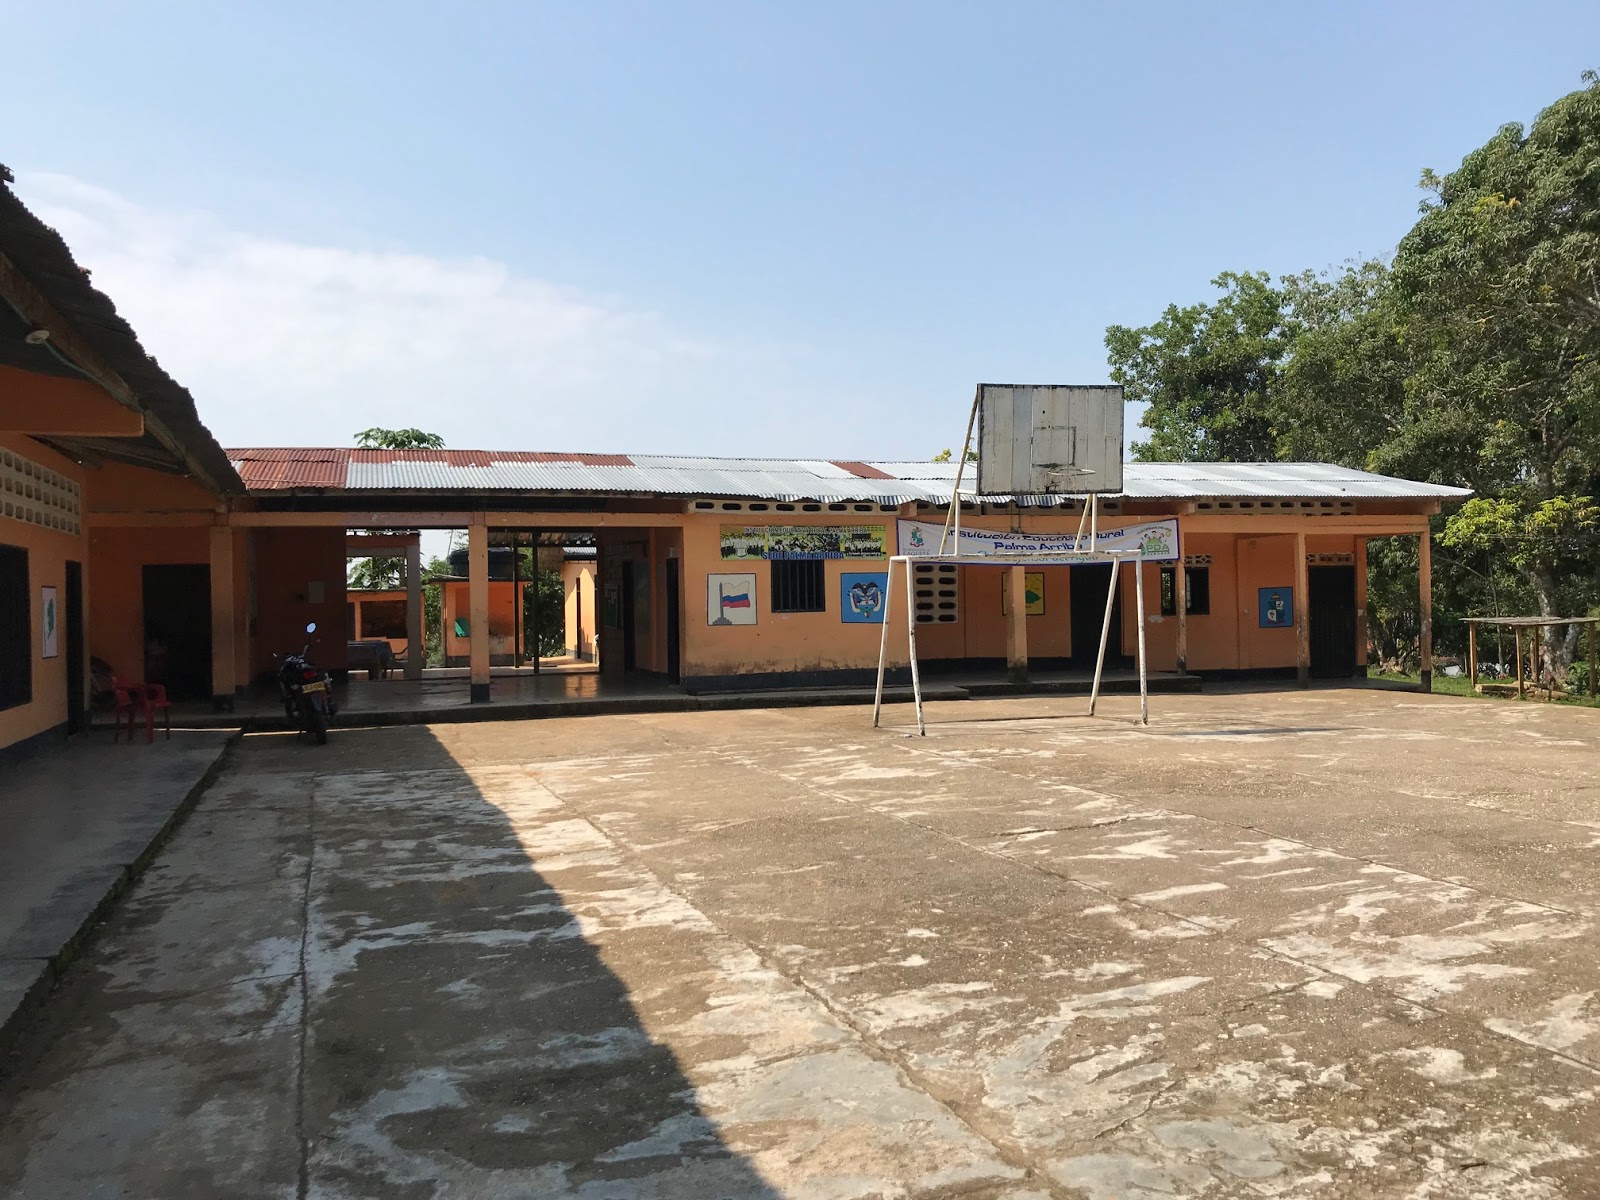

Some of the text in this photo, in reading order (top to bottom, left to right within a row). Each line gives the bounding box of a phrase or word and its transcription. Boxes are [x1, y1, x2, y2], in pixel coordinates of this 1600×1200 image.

[947, 529, 1020, 540] nstitución
[994, 542, 1037, 550] Palma
[762, 551, 783, 560] SEDE
[784, 551, 813, 560] PALMA
[814, 551, 844, 560] ARRIBA
